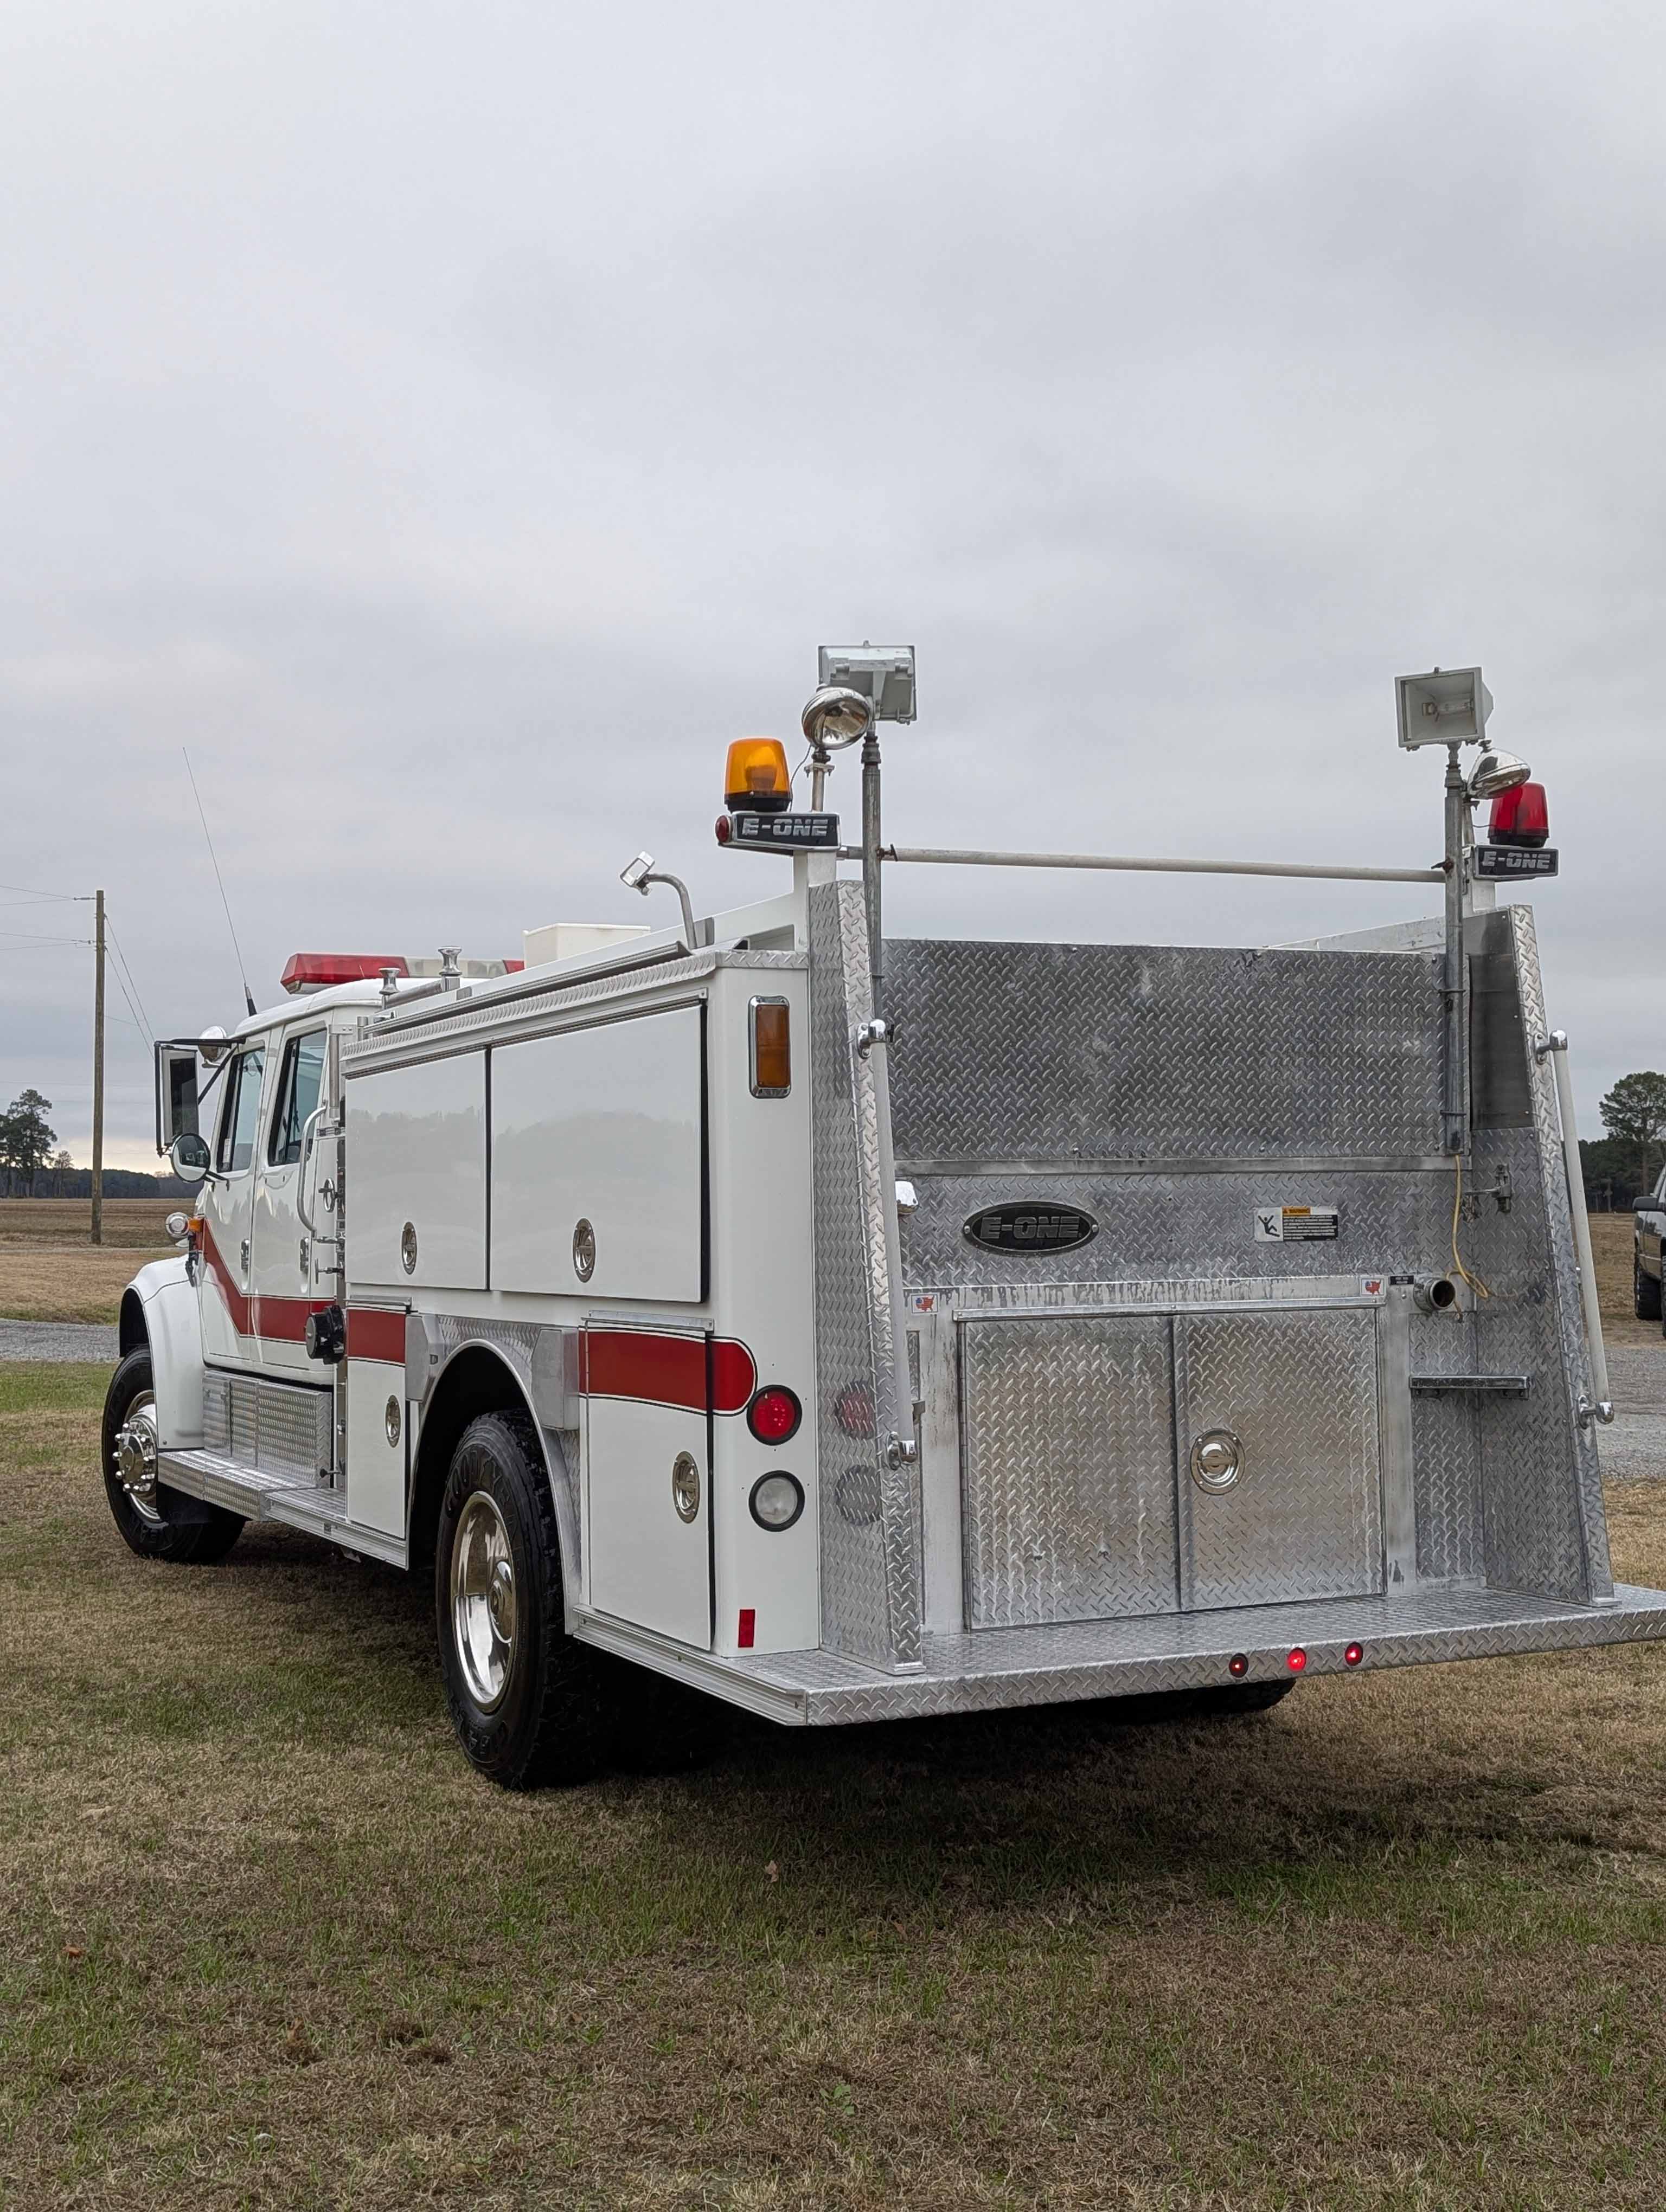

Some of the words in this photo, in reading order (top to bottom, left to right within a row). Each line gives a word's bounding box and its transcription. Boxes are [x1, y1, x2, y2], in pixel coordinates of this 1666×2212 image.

[741, 818, 829, 837] E-ONE
[1482, 851, 1551, 869] E-ONE
[979, 1216, 1080, 1239] E-ONE
